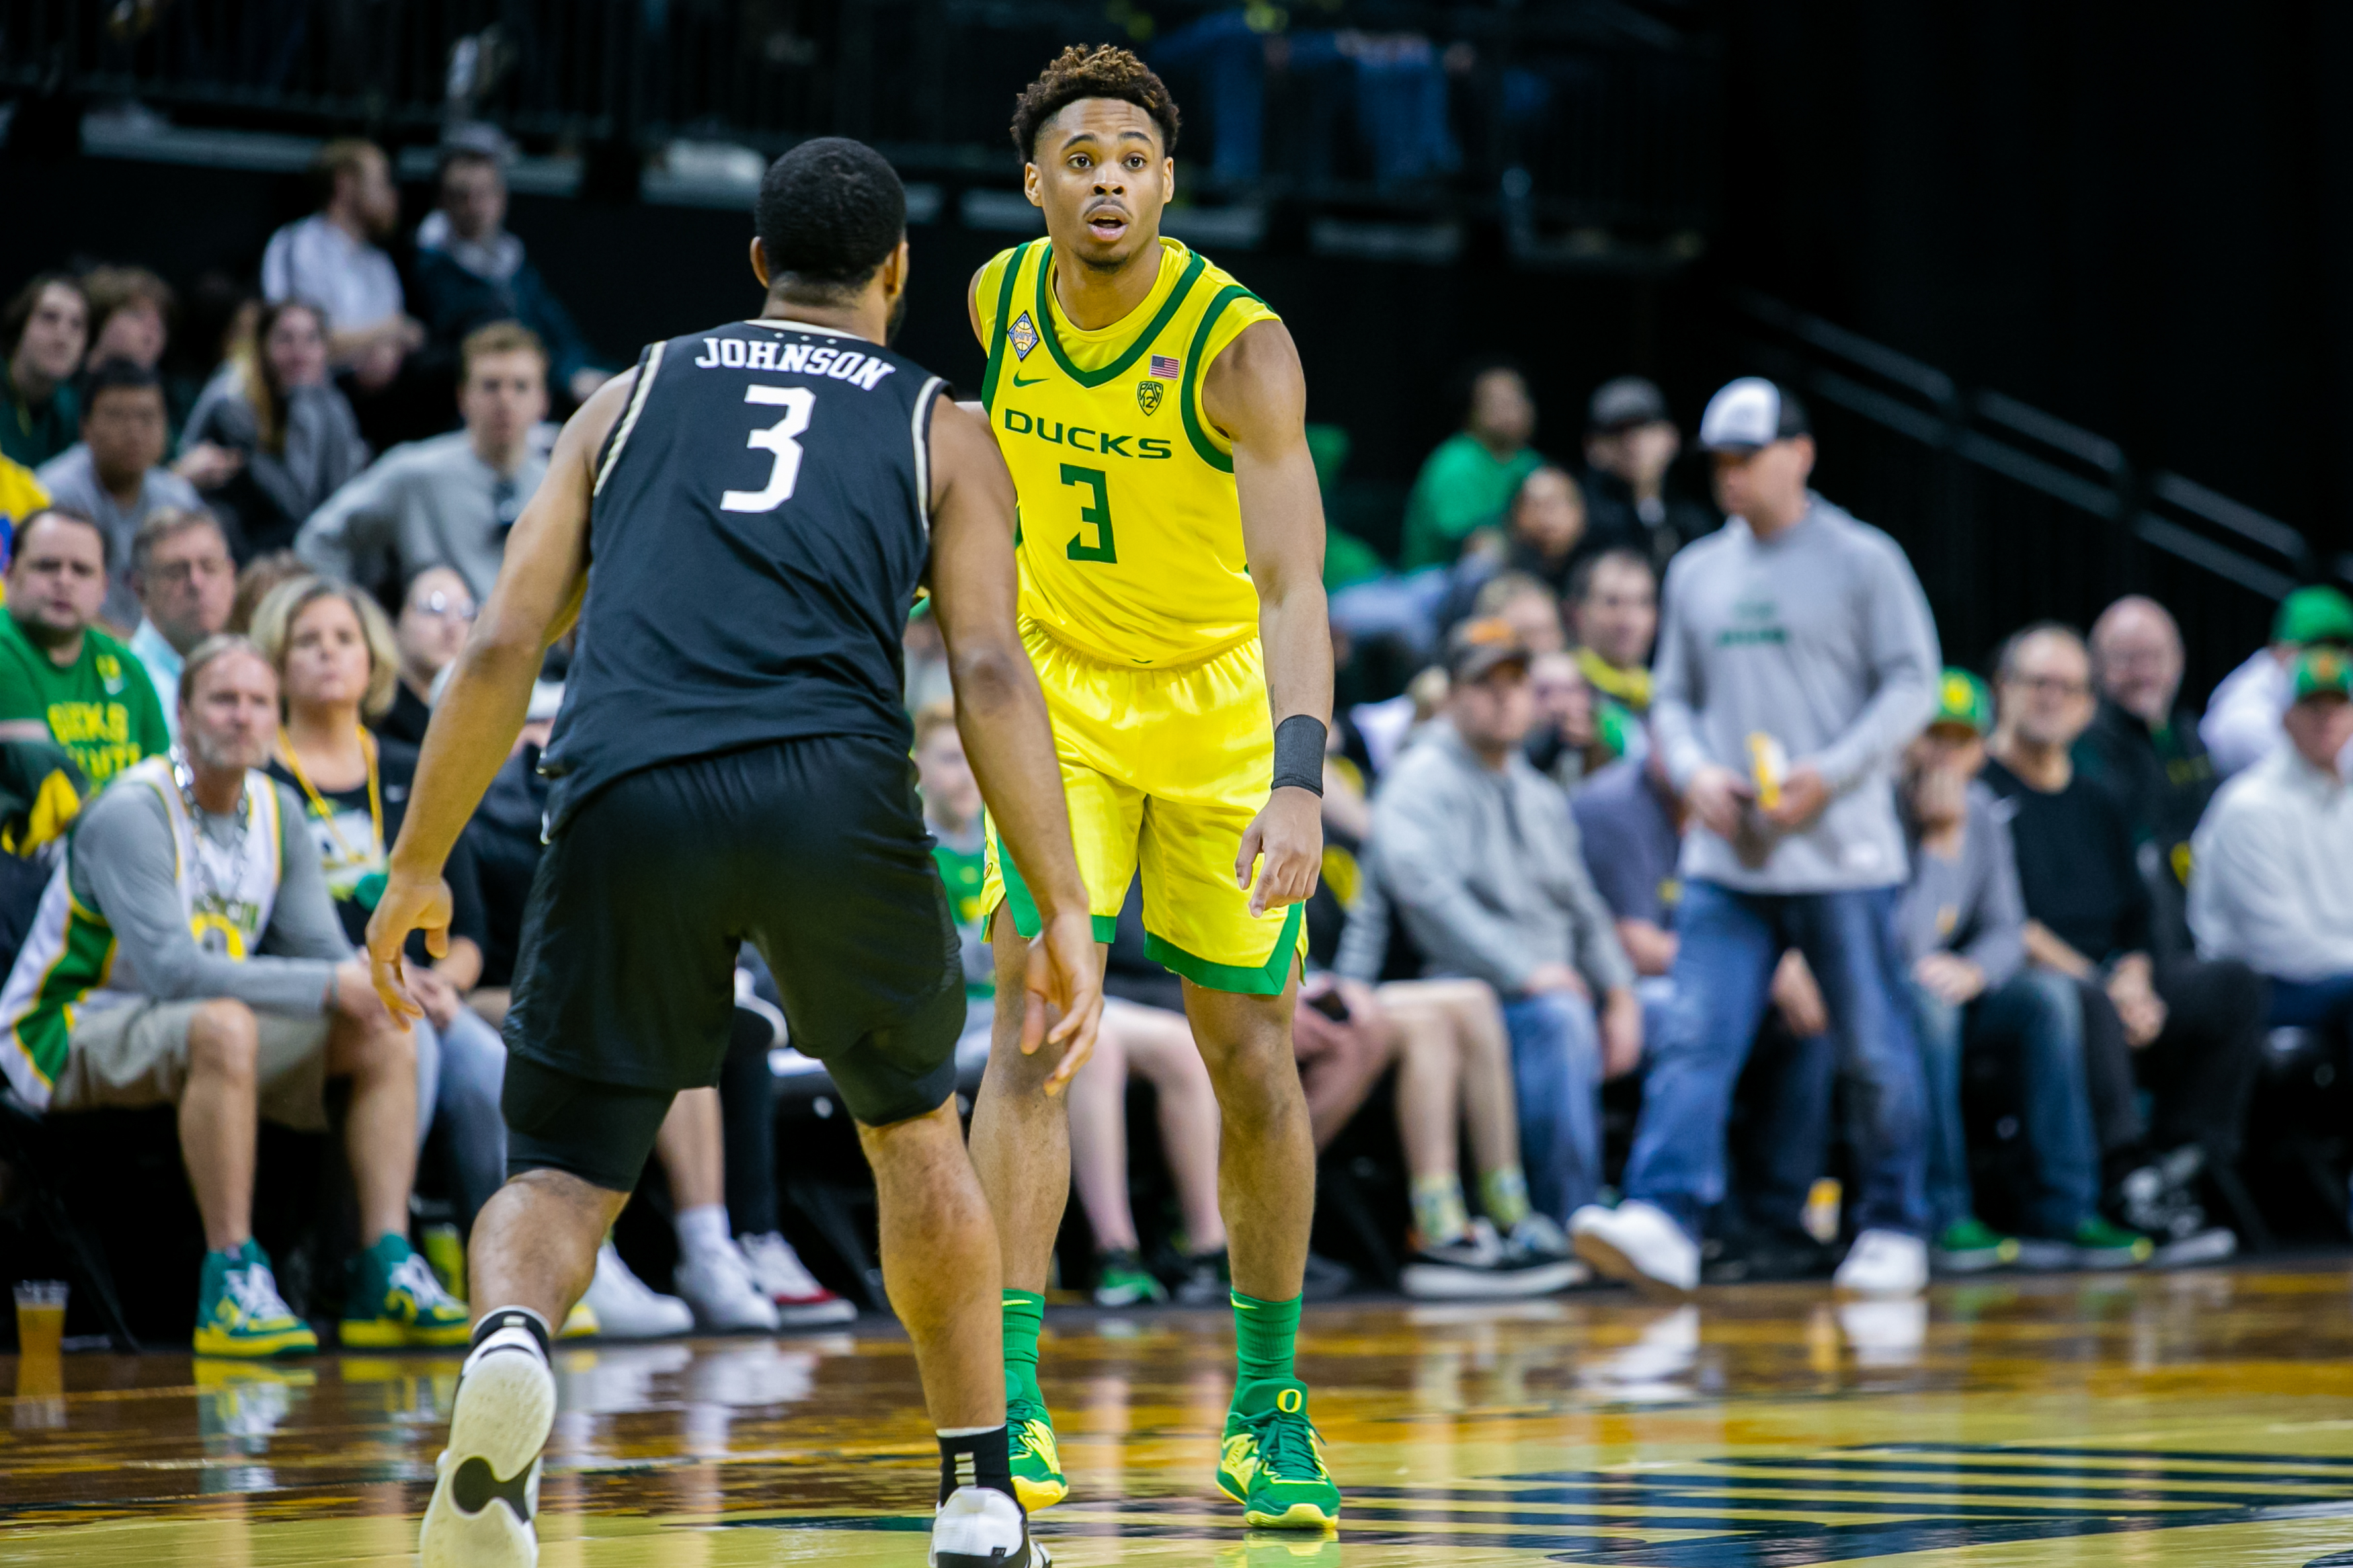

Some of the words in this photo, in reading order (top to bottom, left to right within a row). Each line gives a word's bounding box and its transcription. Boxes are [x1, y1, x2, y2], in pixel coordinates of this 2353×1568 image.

[1014, 329, 1032, 341] NIT
[694, 337, 896, 391] JOHNSON
[1140, 383, 1162, 403] PAC
[1143, 396, 1154, 408] 12
[719, 384, 817, 513] 3
[1004, 408, 1172, 460] DUCKS
[1060, 462, 1118, 564] 3
[1277, 1388, 1303, 1414] O
